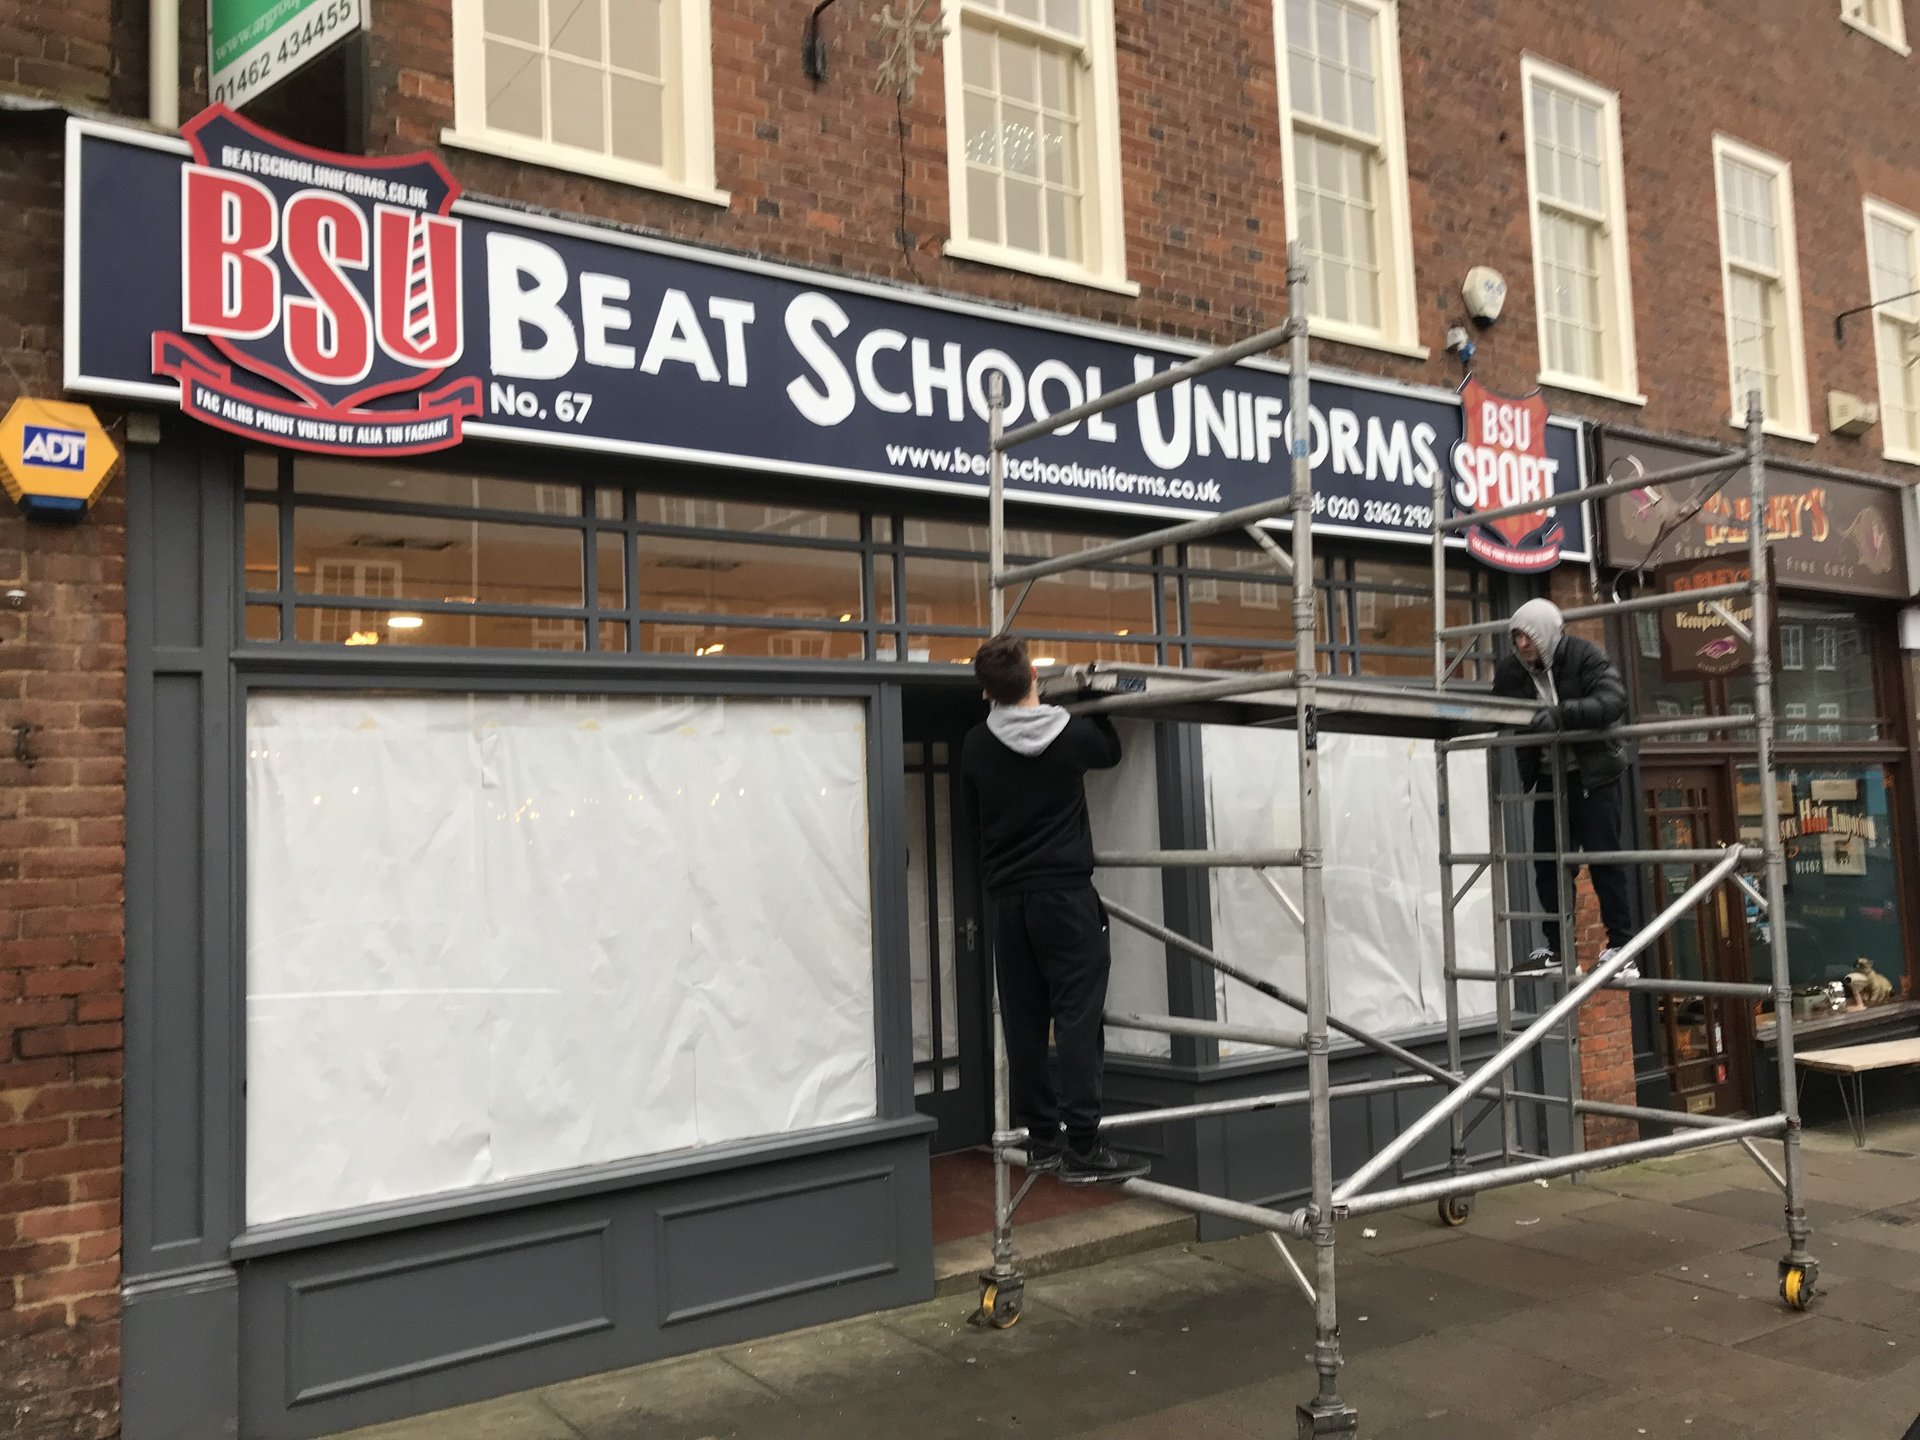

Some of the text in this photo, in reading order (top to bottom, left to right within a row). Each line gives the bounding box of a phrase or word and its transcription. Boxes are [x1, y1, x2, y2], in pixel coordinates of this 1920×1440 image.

[215, 0, 351, 103] 01462 434455
[221, 145, 428, 209] BEATSCHOOLUNIFORMS.CO.UK
[181, 161, 463, 385] BSU
[486, 231, 1439, 489] BEAT SCHOOL UNIFORMS
[256, 410, 295, 435] PROUT
[297, 420, 338, 442] VULTIS
[339, 425, 354, 443] UT
[356, 426, 382, 444] ALIA
[385, 425, 404, 443] TUI
[405, 418, 449, 441] FACIANT
[555, 391, 593, 424] 67
[1482, 400, 1530, 451] BSU
[23, 431, 87, 466] ADT
[886, 443, 1222, 504] www.betschooluniforms.co.uk
[1454, 442, 1559, 517] SPORT
[1327, 494, 1360, 520] 020
[1363, 500, 1402, 526] 3362
[1403, 504, 1434, 529] 293
